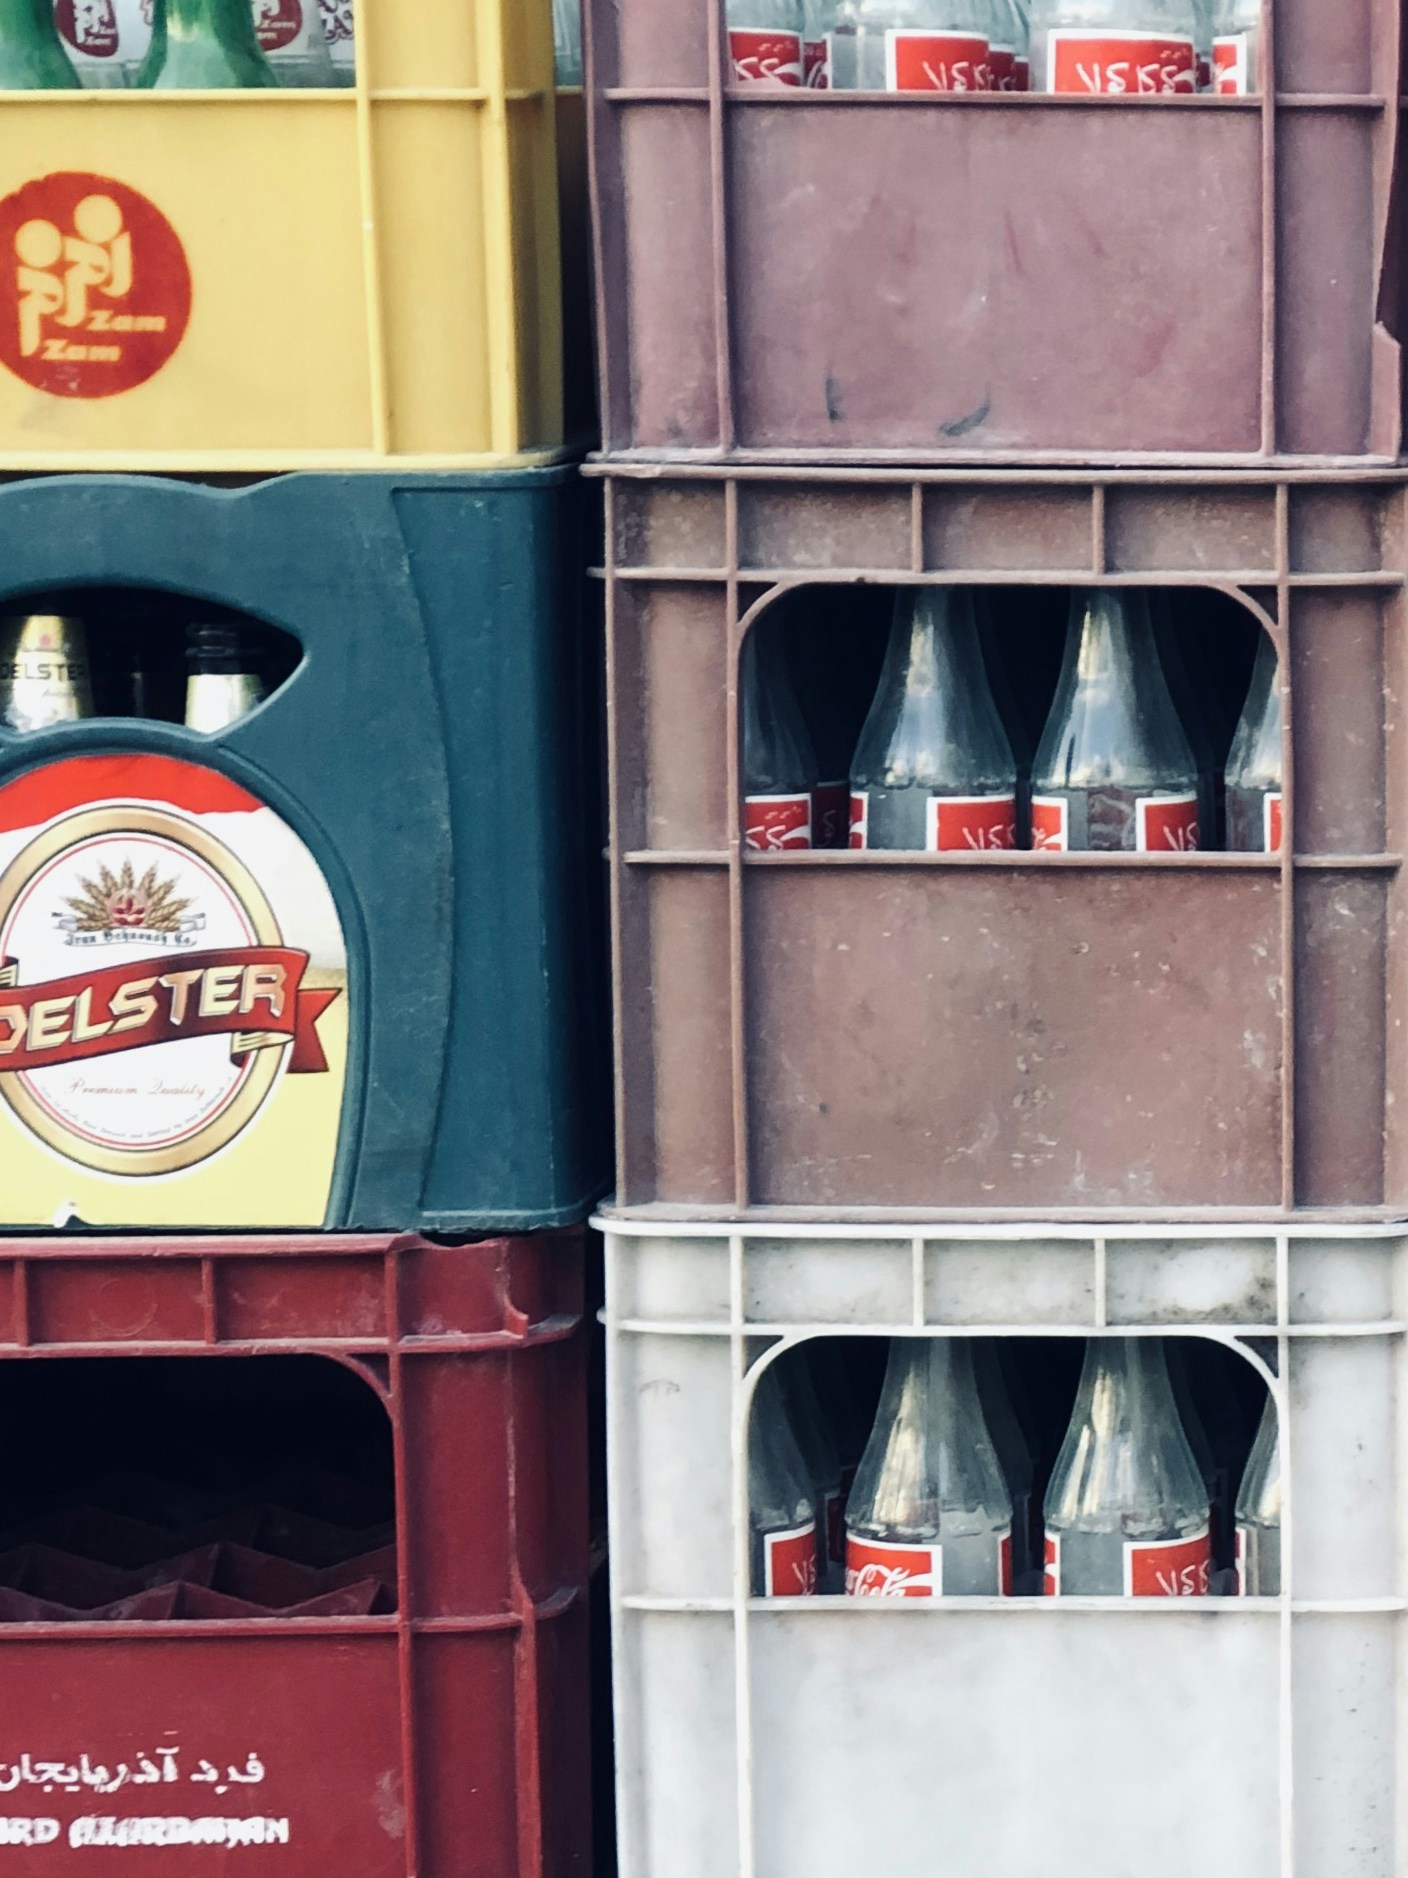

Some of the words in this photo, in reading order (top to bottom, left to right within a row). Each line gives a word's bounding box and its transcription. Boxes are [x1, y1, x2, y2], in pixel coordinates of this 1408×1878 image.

[85, 308, 167, 332] Zam
[41, 338, 122, 362] Zam
[67, 1076, 139, 1094] Premium
[147, 1077, 206, 1099] Quality
[190, 1752, 265, 1794] فرد
